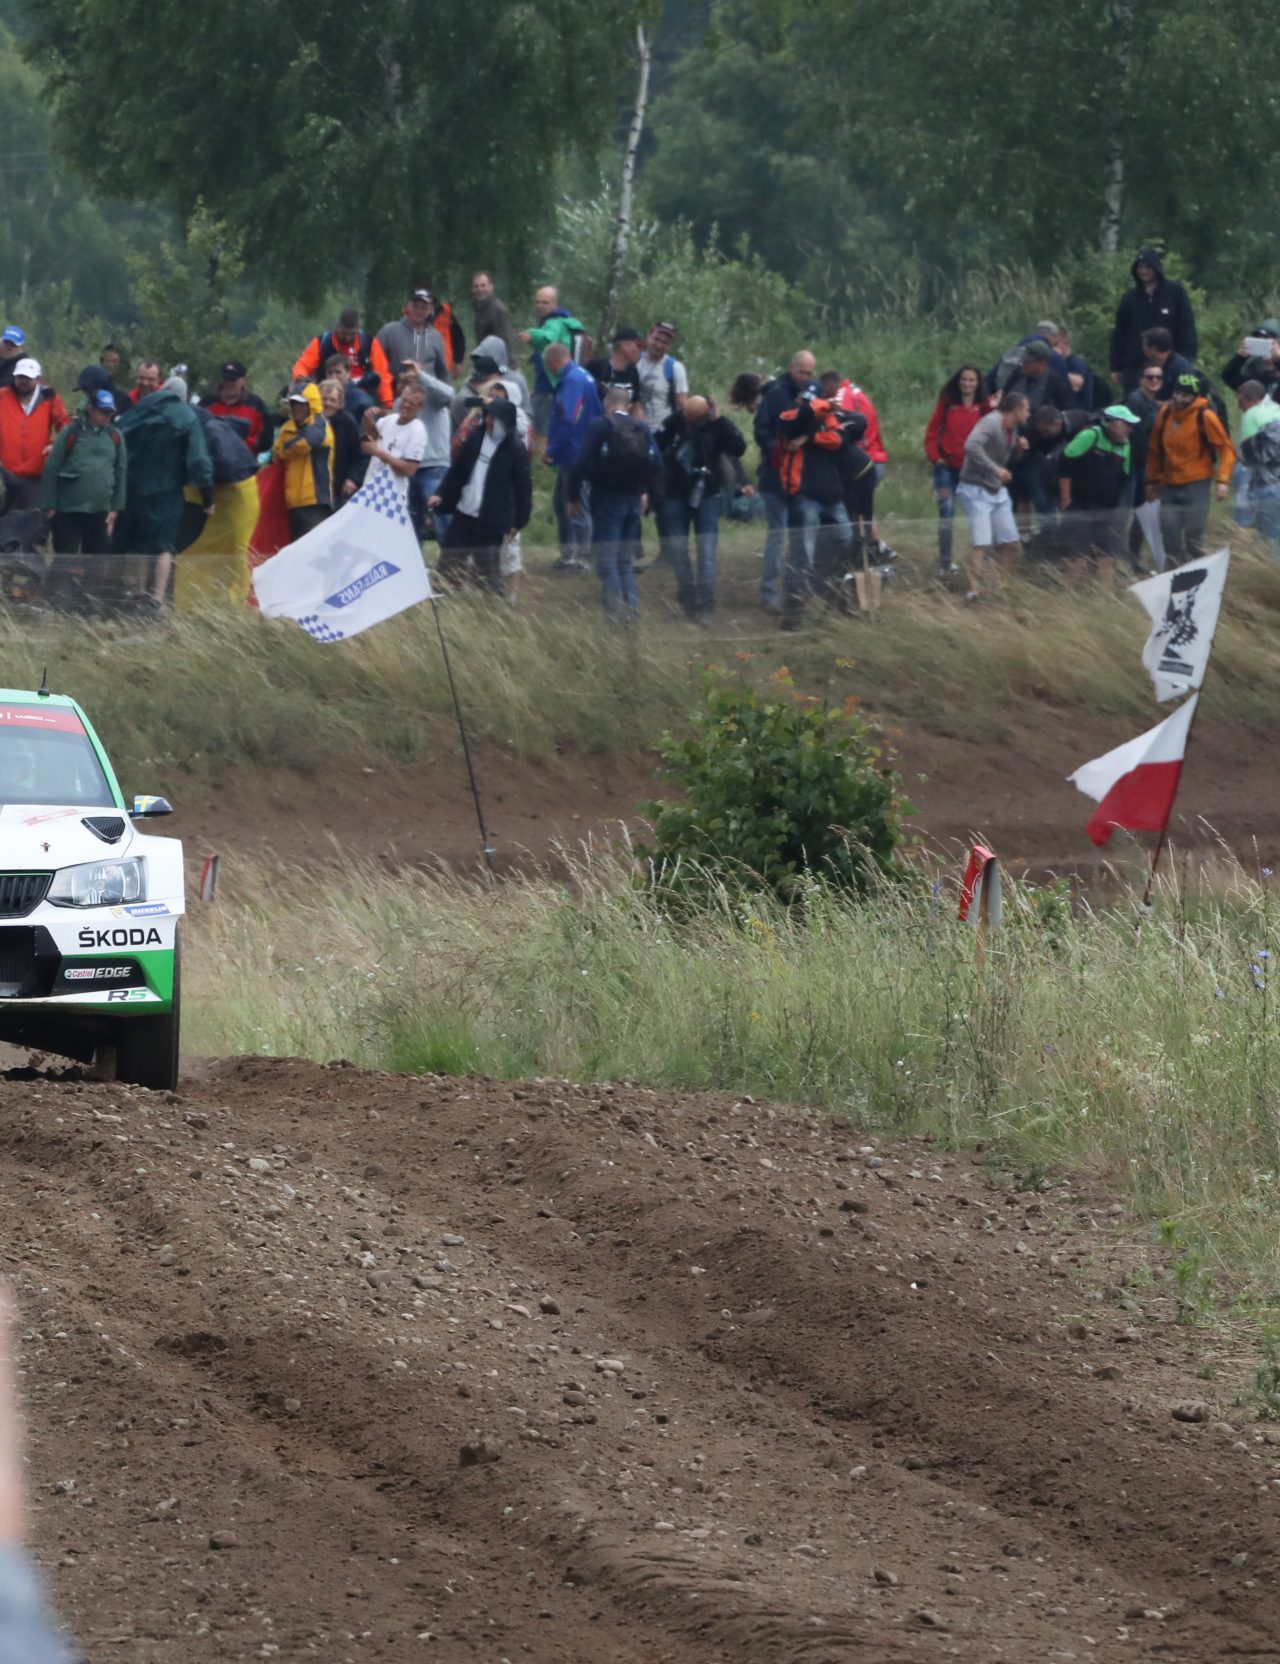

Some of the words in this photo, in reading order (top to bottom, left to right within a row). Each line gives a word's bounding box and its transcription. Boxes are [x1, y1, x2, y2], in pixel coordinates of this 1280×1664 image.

[130, 905, 167, 915] MICHELIN
[78, 926, 162, 948] ŠKODA
[72, 969, 95, 978] Castrol
[94, 966, 132, 979] EDGE
[107, 989, 148, 1001] R5
